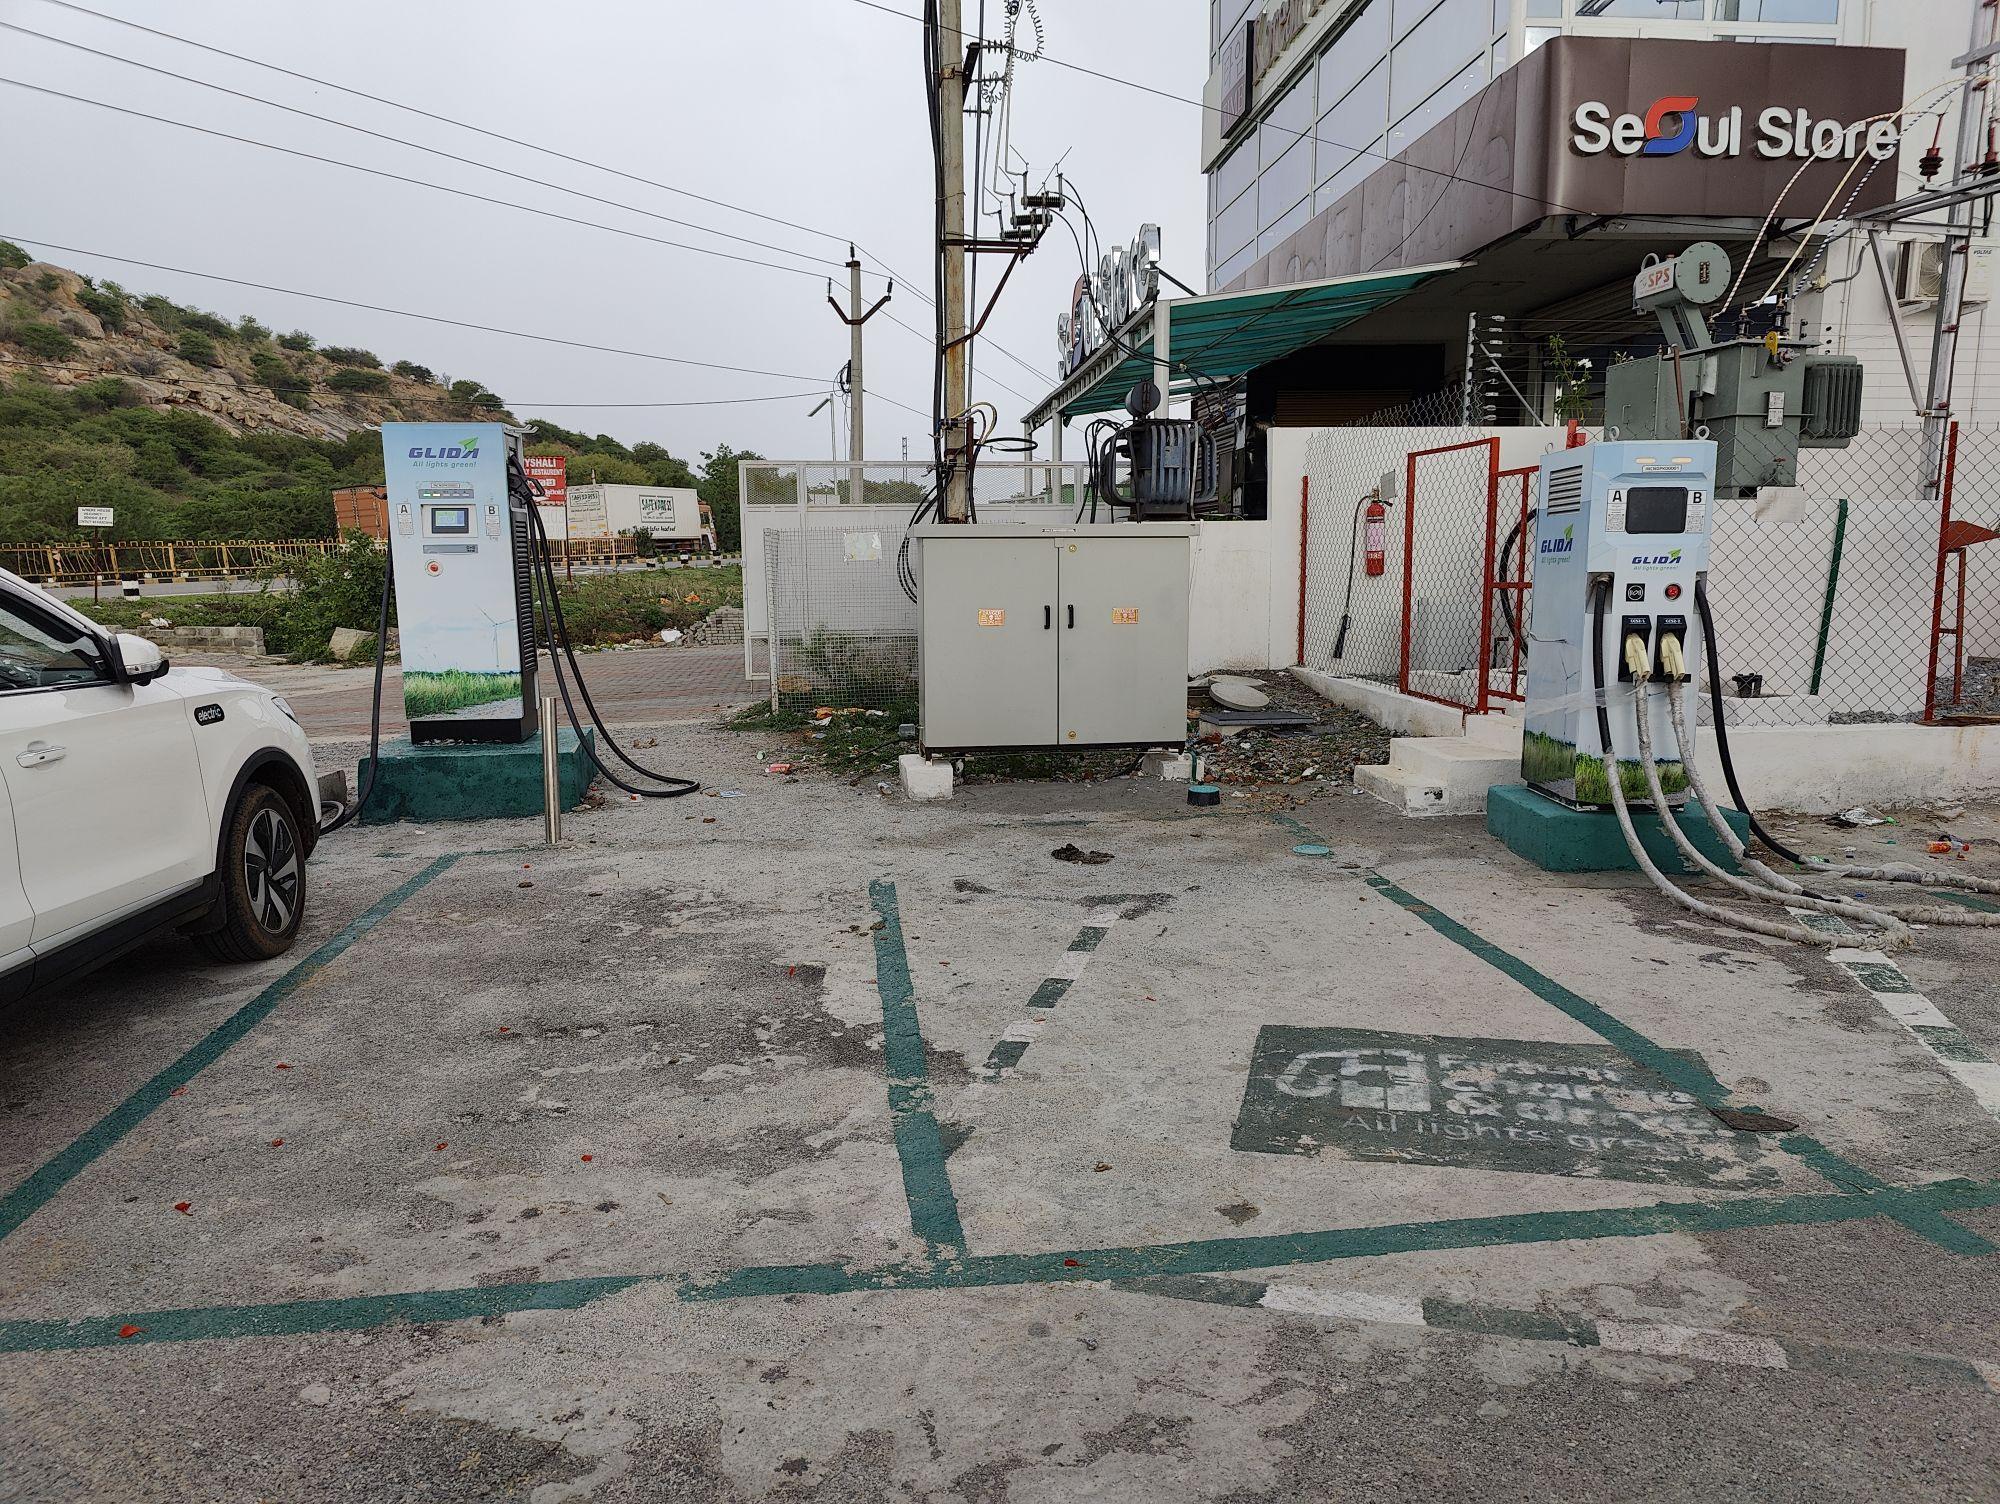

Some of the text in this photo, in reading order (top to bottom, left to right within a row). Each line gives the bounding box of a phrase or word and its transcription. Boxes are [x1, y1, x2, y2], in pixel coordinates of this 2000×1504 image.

[1574, 96, 1899, 161] Seoul Store
[1648, 267, 1670, 287] SPS
[409, 446, 479, 458] GLIDA
[524, 458, 557, 468] YSHALI
[1612, 491, 1622, 502] A
[1693, 492, 1702, 504] B
[400, 504, 408, 514] A
[488, 505, 496, 515] B
[1541, 536, 1573, 553] GLIDA
[1631, 555, 1682, 564] GLIDA
[198, 706, 221, 721] electric
[1342, 1114, 1398, 1133] All
[1417, 1118, 1551, 1142] lights
